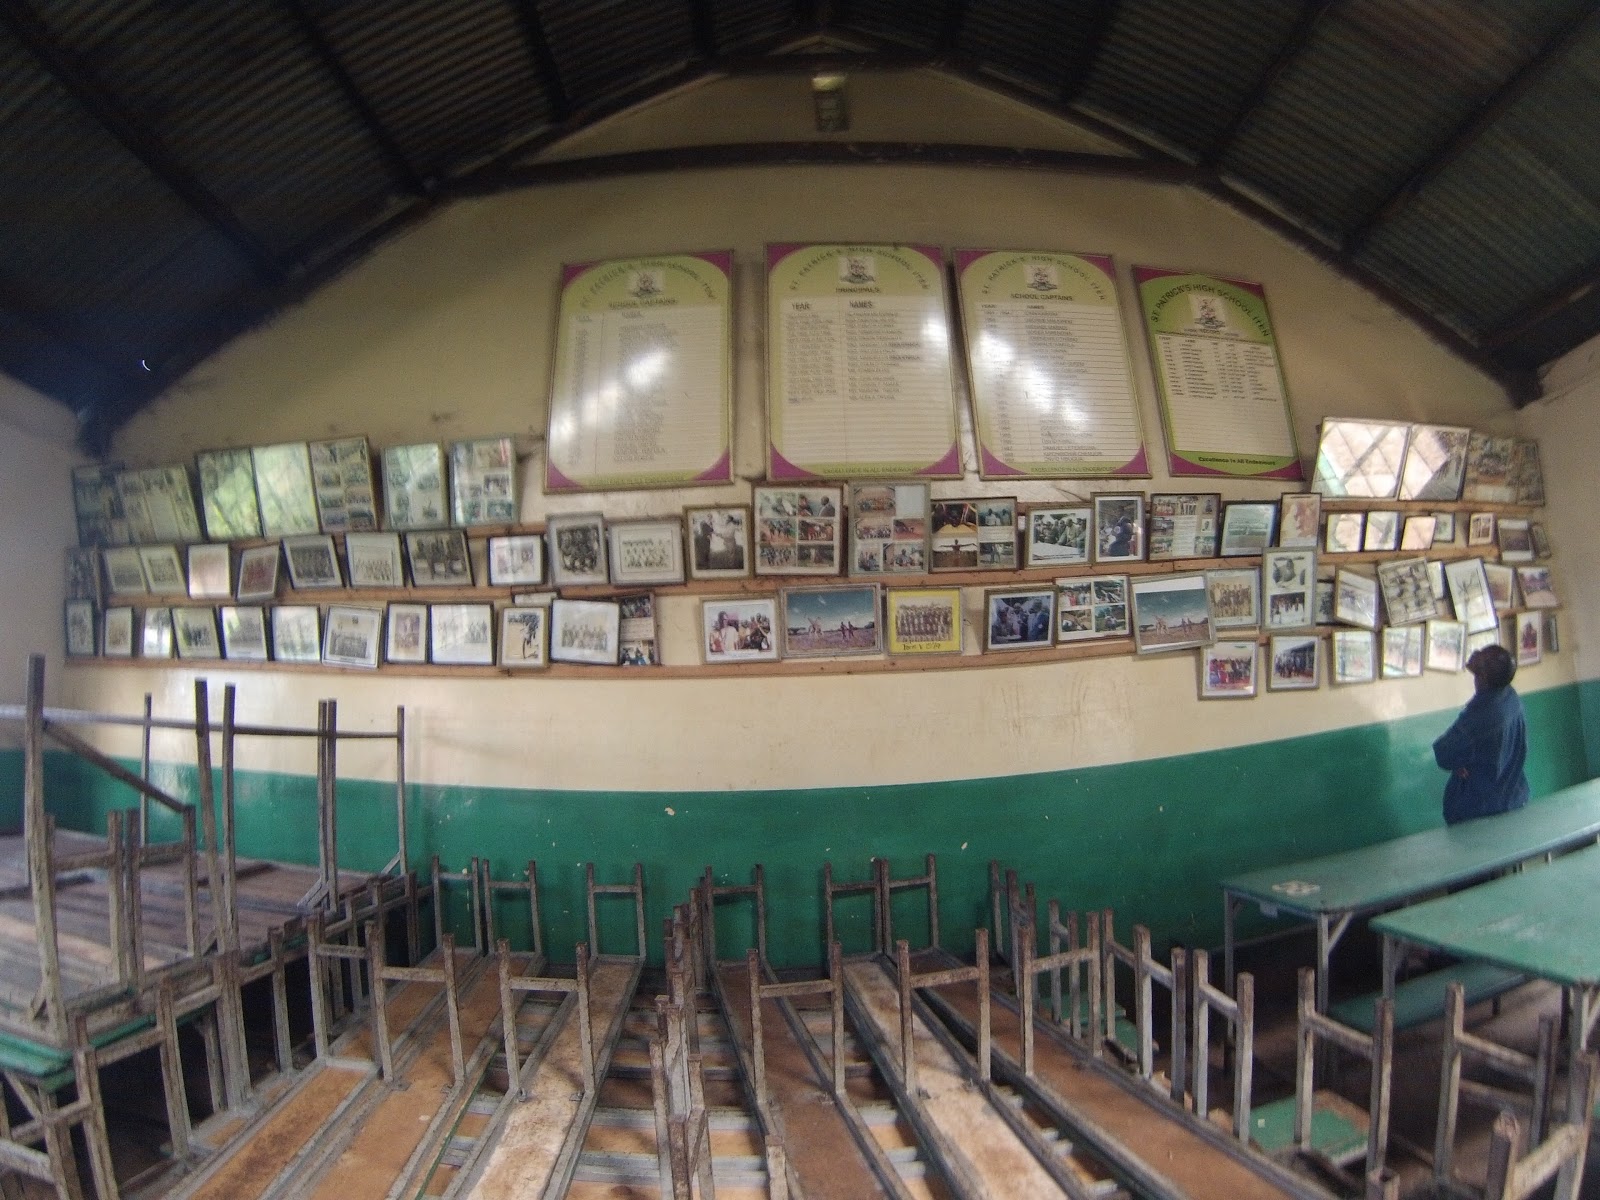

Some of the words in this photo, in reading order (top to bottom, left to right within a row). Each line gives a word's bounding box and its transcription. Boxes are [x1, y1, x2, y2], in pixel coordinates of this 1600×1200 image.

[988, 256, 1027, 281] PATRICK'S
[1056, 259, 1090, 281] SCHOOL
[1090, 282, 1105, 300] ITEN
[849, 300, 874, 309] NAMES
[1155, 284, 1192, 309] PATRICK'S
[1192, 284, 1215, 294] HIGH
[1216, 289, 1253, 317] SCHOOL
[1251, 316, 1270, 337] ITEN
[1198, 456, 1230, 464] Excellence
